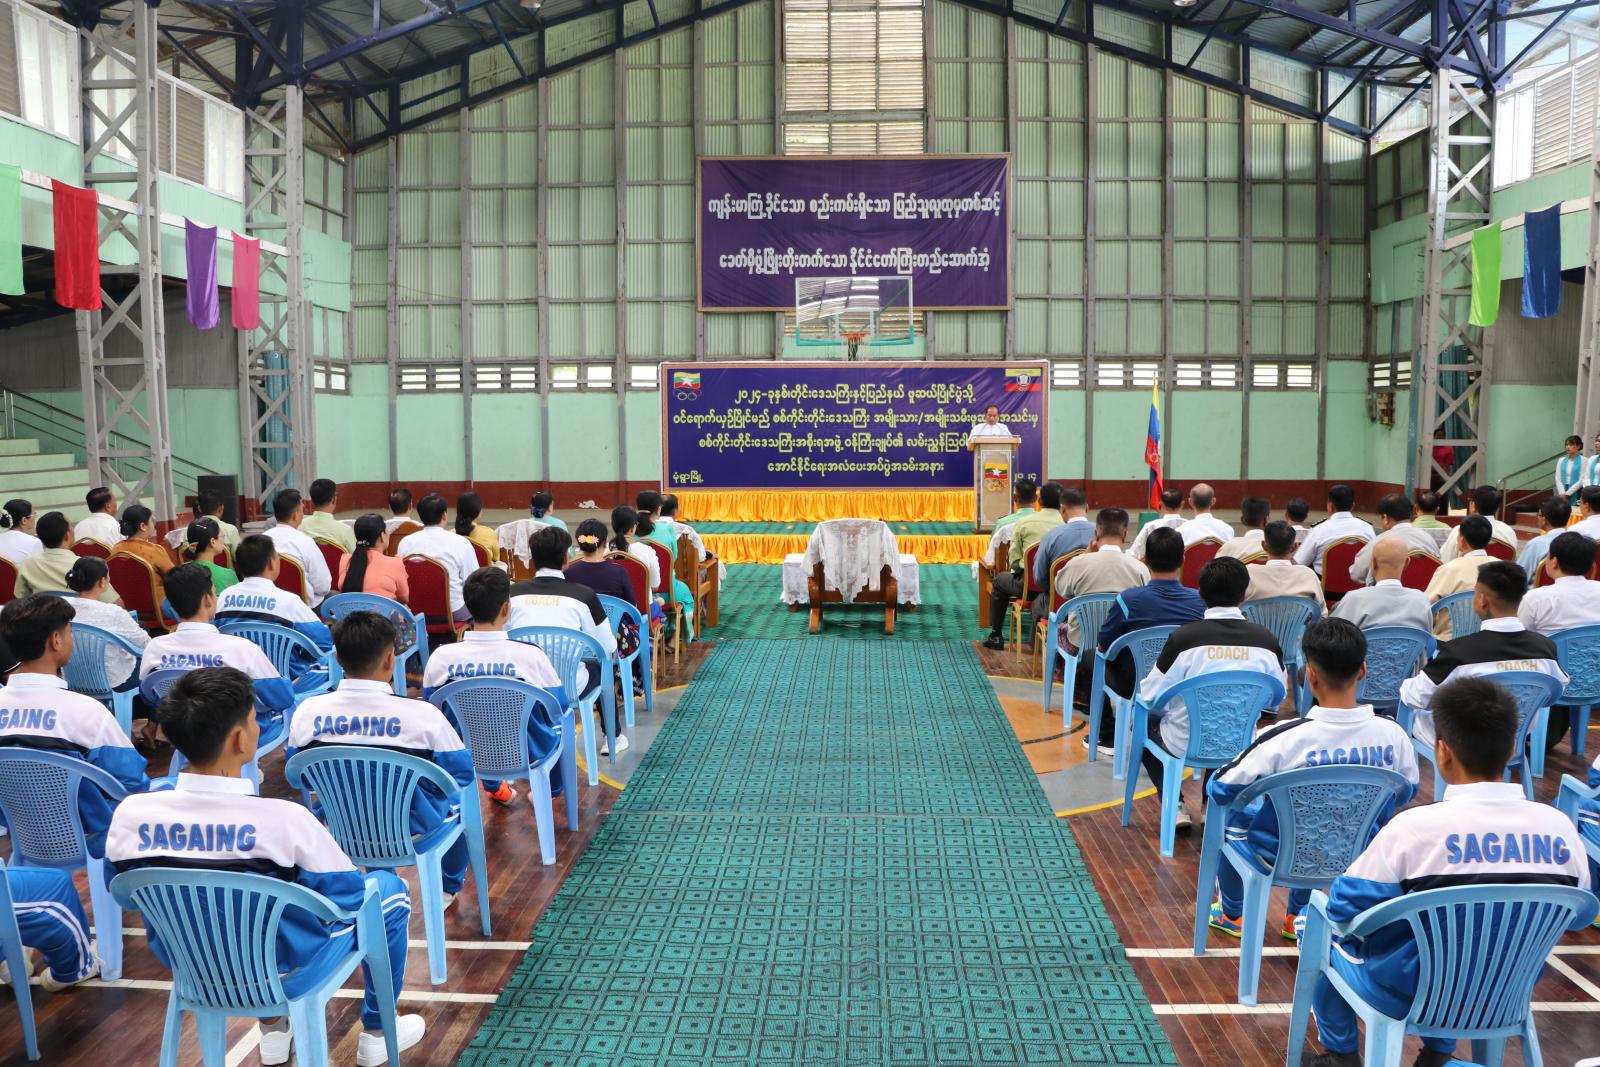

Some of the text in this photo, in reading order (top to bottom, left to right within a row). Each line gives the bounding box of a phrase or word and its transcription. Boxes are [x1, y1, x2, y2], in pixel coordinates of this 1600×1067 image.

[809, 192, 890, 220] စည်းကမ်းရှိသော
[223, 594, 277, 611] SAGAING
[160, 653, 224, 668] SAGAING
[1207, 646, 1249, 660] COACH
[448, 662, 517, 677] SAGAING
[0, 708, 57, 731] GAING
[312, 715, 401, 738] SAGAING
[1305, 744, 1395, 768] SAGAING
[138, 822, 257, 852] SAGAING
[1445, 832, 1572, 866] SAGAING
